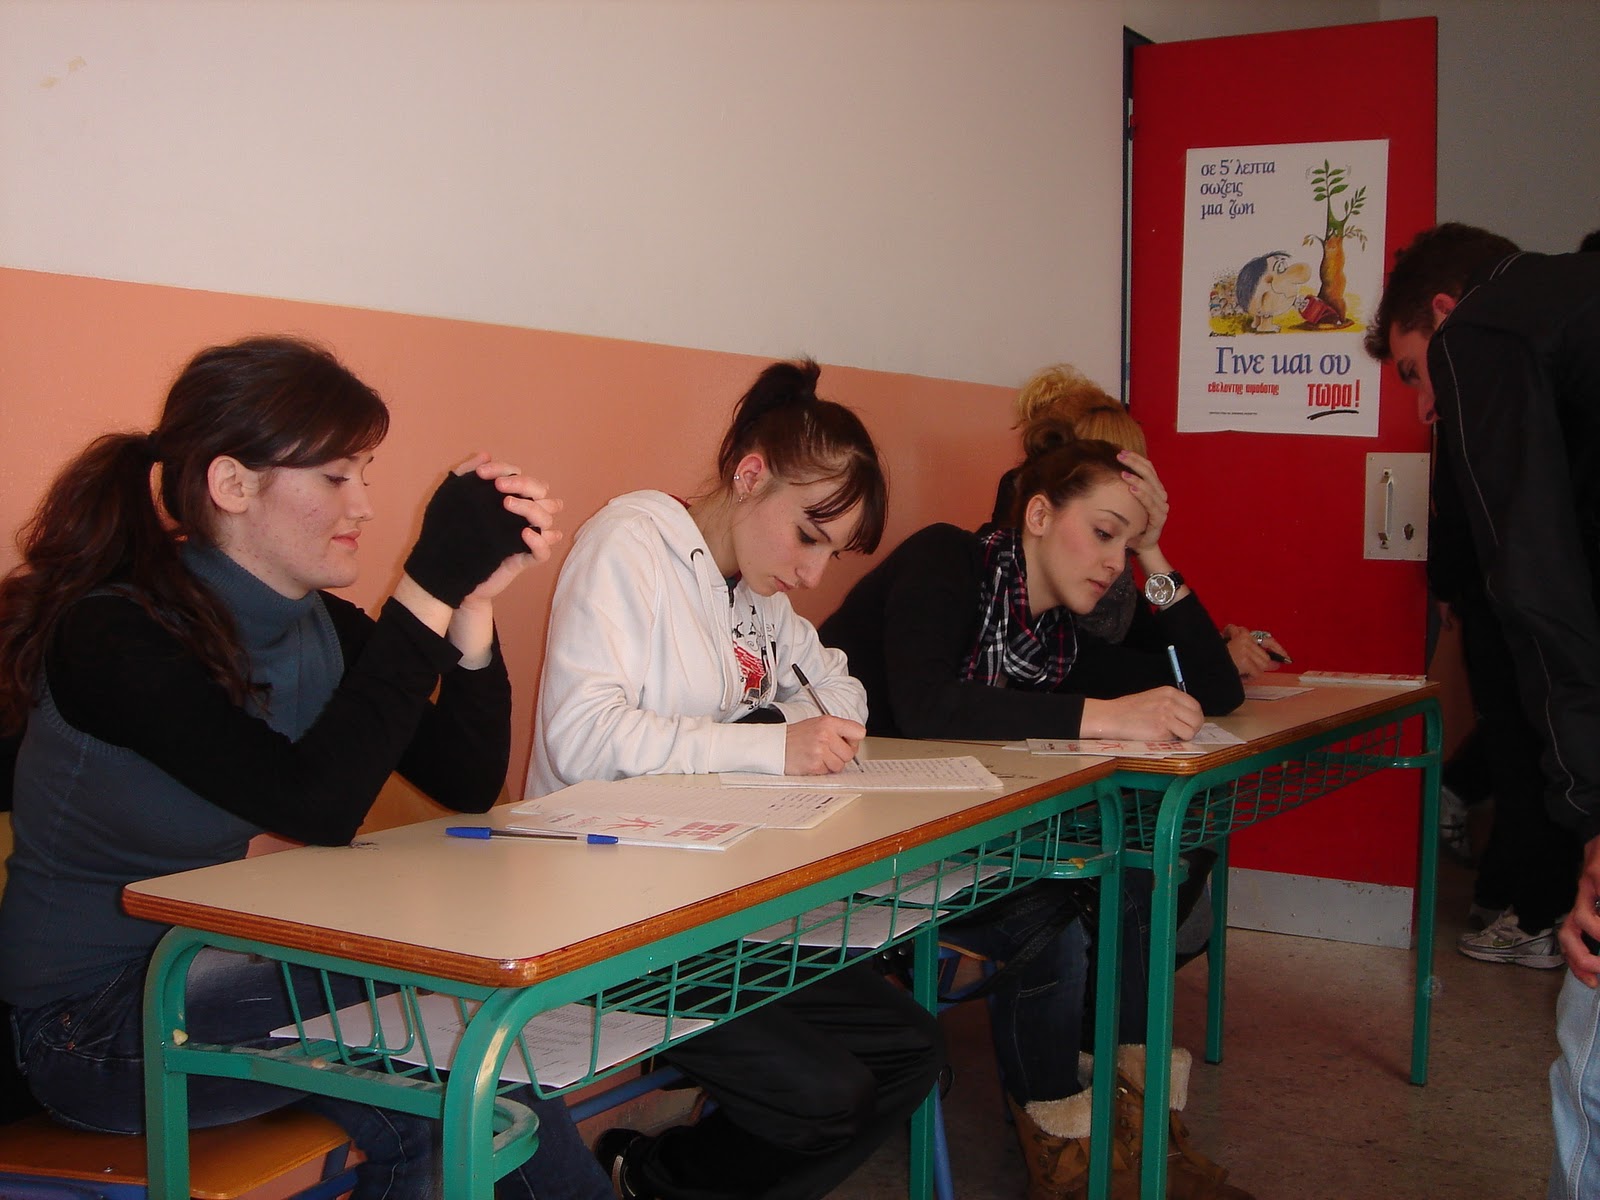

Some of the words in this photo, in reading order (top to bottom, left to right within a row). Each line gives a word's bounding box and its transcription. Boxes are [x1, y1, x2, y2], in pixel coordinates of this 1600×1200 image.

[1201, 163, 1216, 176] σε
[1235, 159, 1276, 175] λεπτα
[1200, 179, 1243, 198] σωζεις
[1201, 203, 1223, 219] μια
[1229, 199, 1255, 219] ζωη
[1215, 347, 1265, 375] Γινε
[1271, 353, 1313, 375] και
